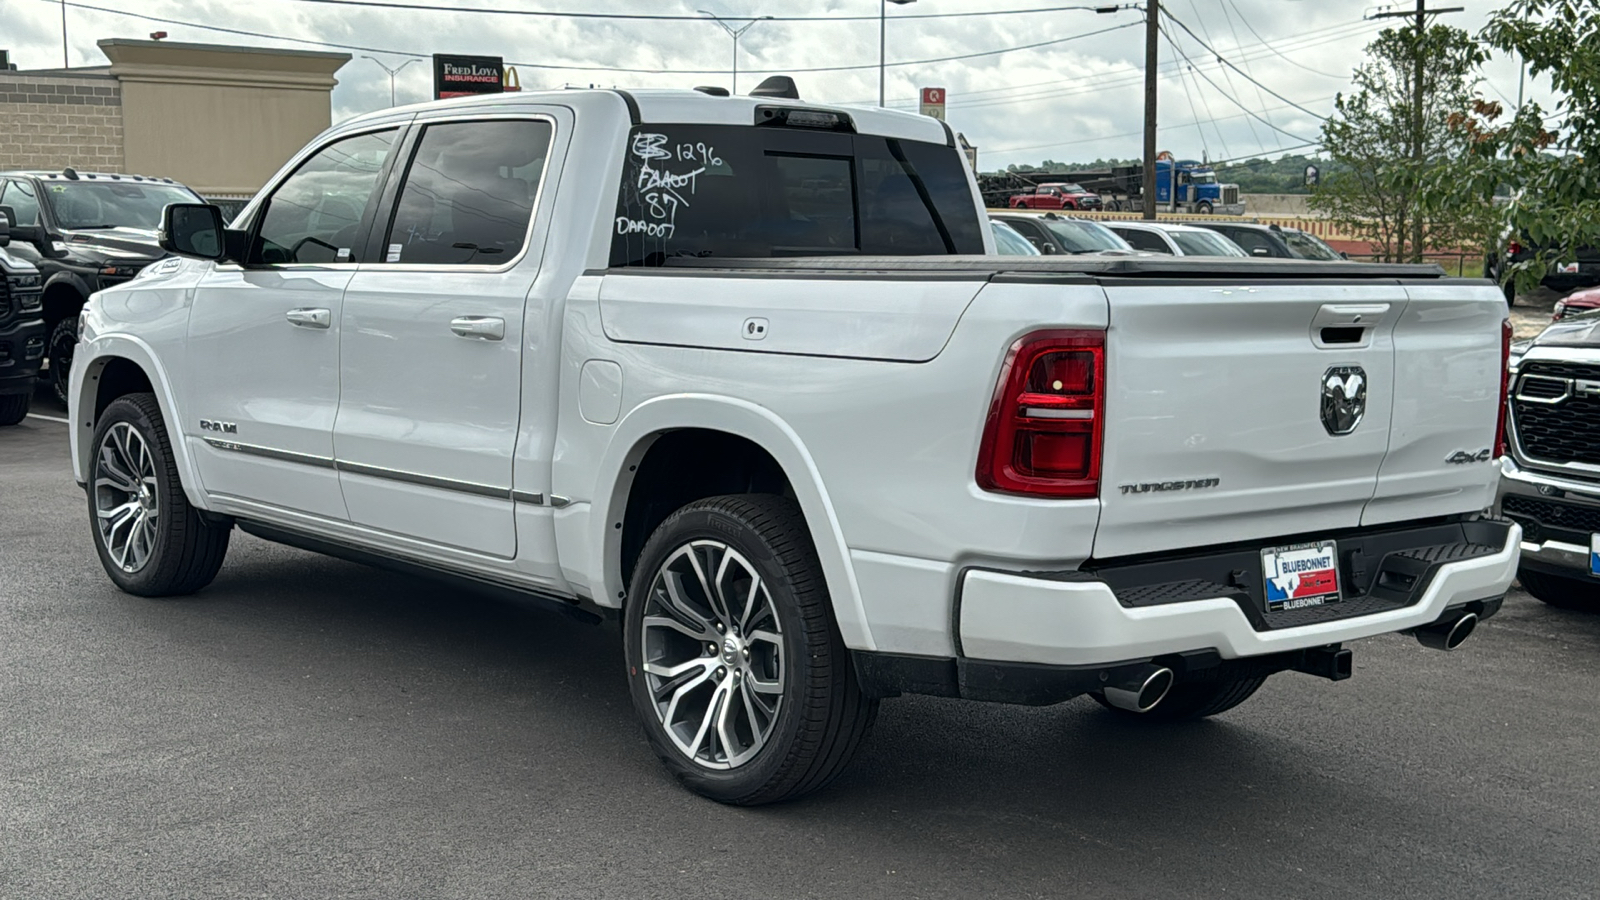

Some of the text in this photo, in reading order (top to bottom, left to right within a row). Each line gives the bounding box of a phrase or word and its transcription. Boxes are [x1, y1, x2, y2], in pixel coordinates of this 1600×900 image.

[443, 63, 498, 76] FRED LOYA
[444, 75, 498, 83] INSURANCE
[676, 142, 722, 166] 1296
[200, 419, 238, 434] RAM
[1118, 477, 1220, 494] TUNGSTEN
[1282, 556, 1331, 573] BLUEBONNET
[1283, 595, 1325, 610] BLUEBONNET
